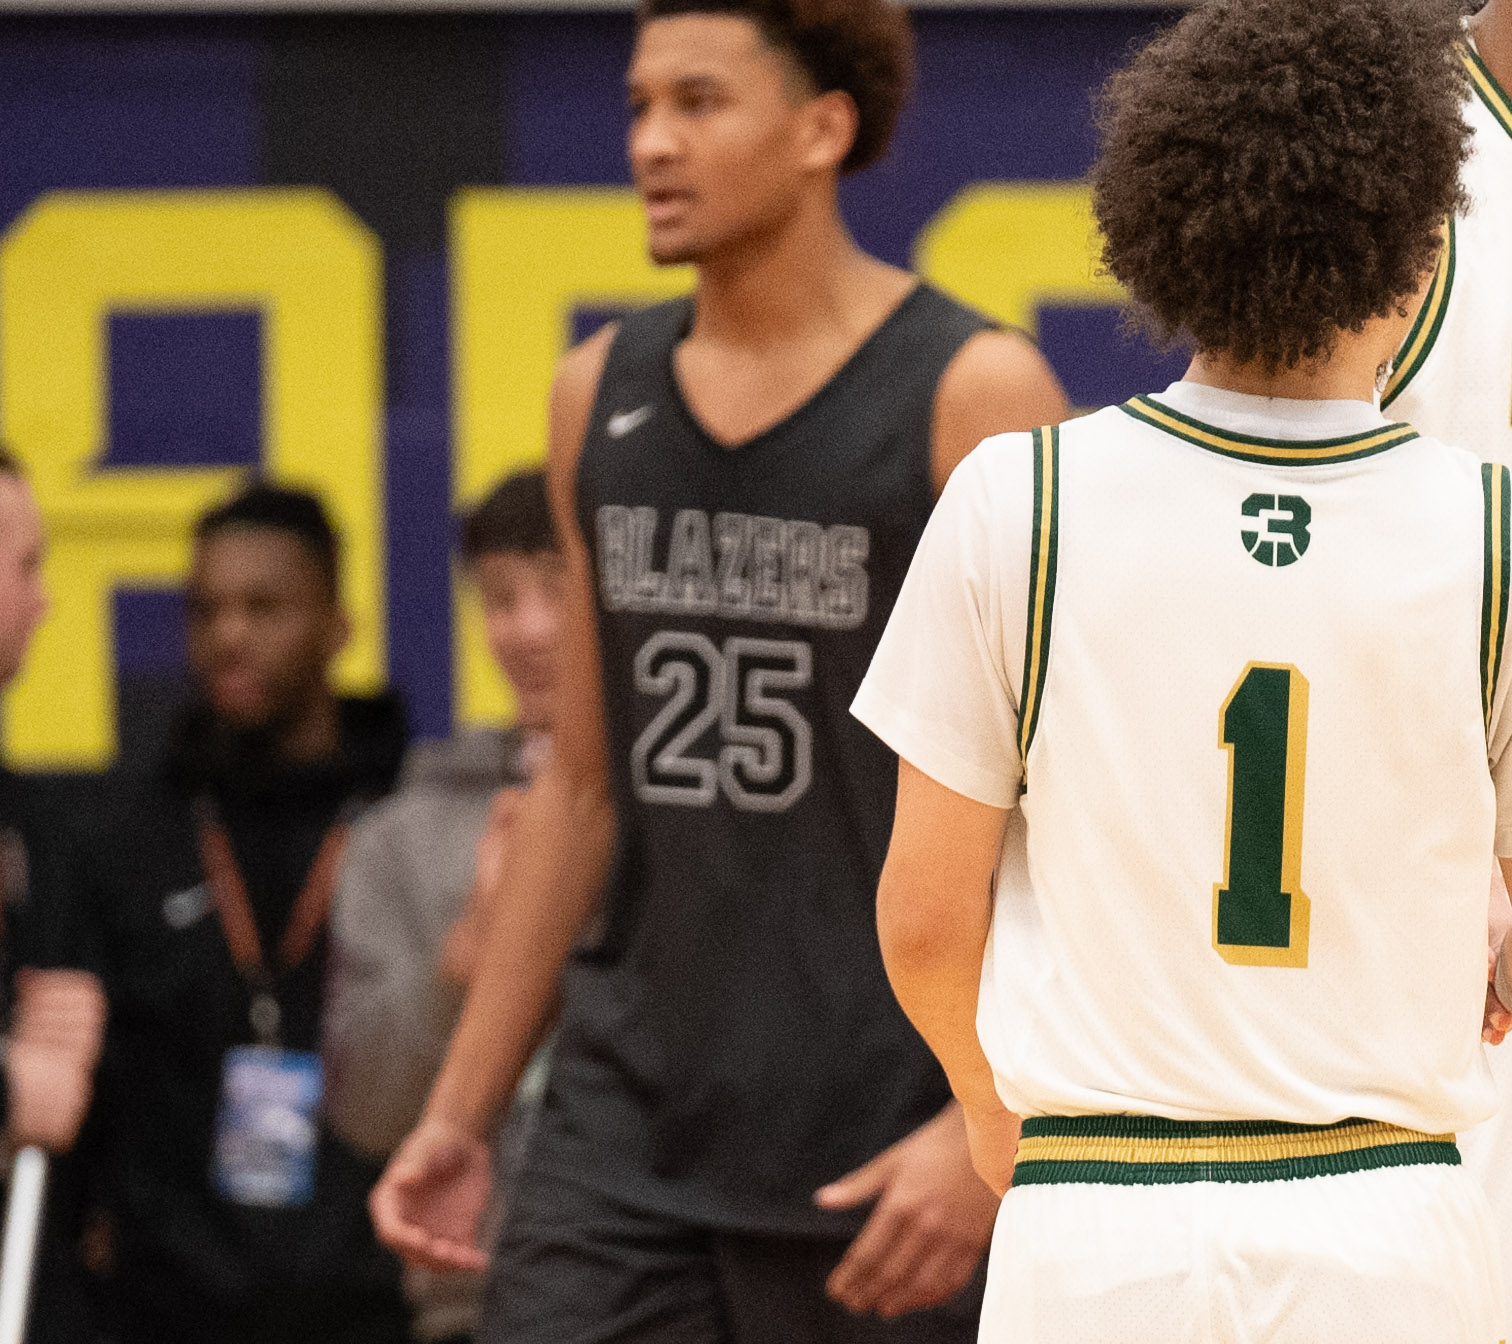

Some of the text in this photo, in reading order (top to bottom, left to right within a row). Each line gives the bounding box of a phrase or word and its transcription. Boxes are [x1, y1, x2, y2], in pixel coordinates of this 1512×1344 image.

[596, 504, 872, 632] BLAZERS
[630, 628, 814, 814] 25
[1210, 659, 1312, 969] 1
